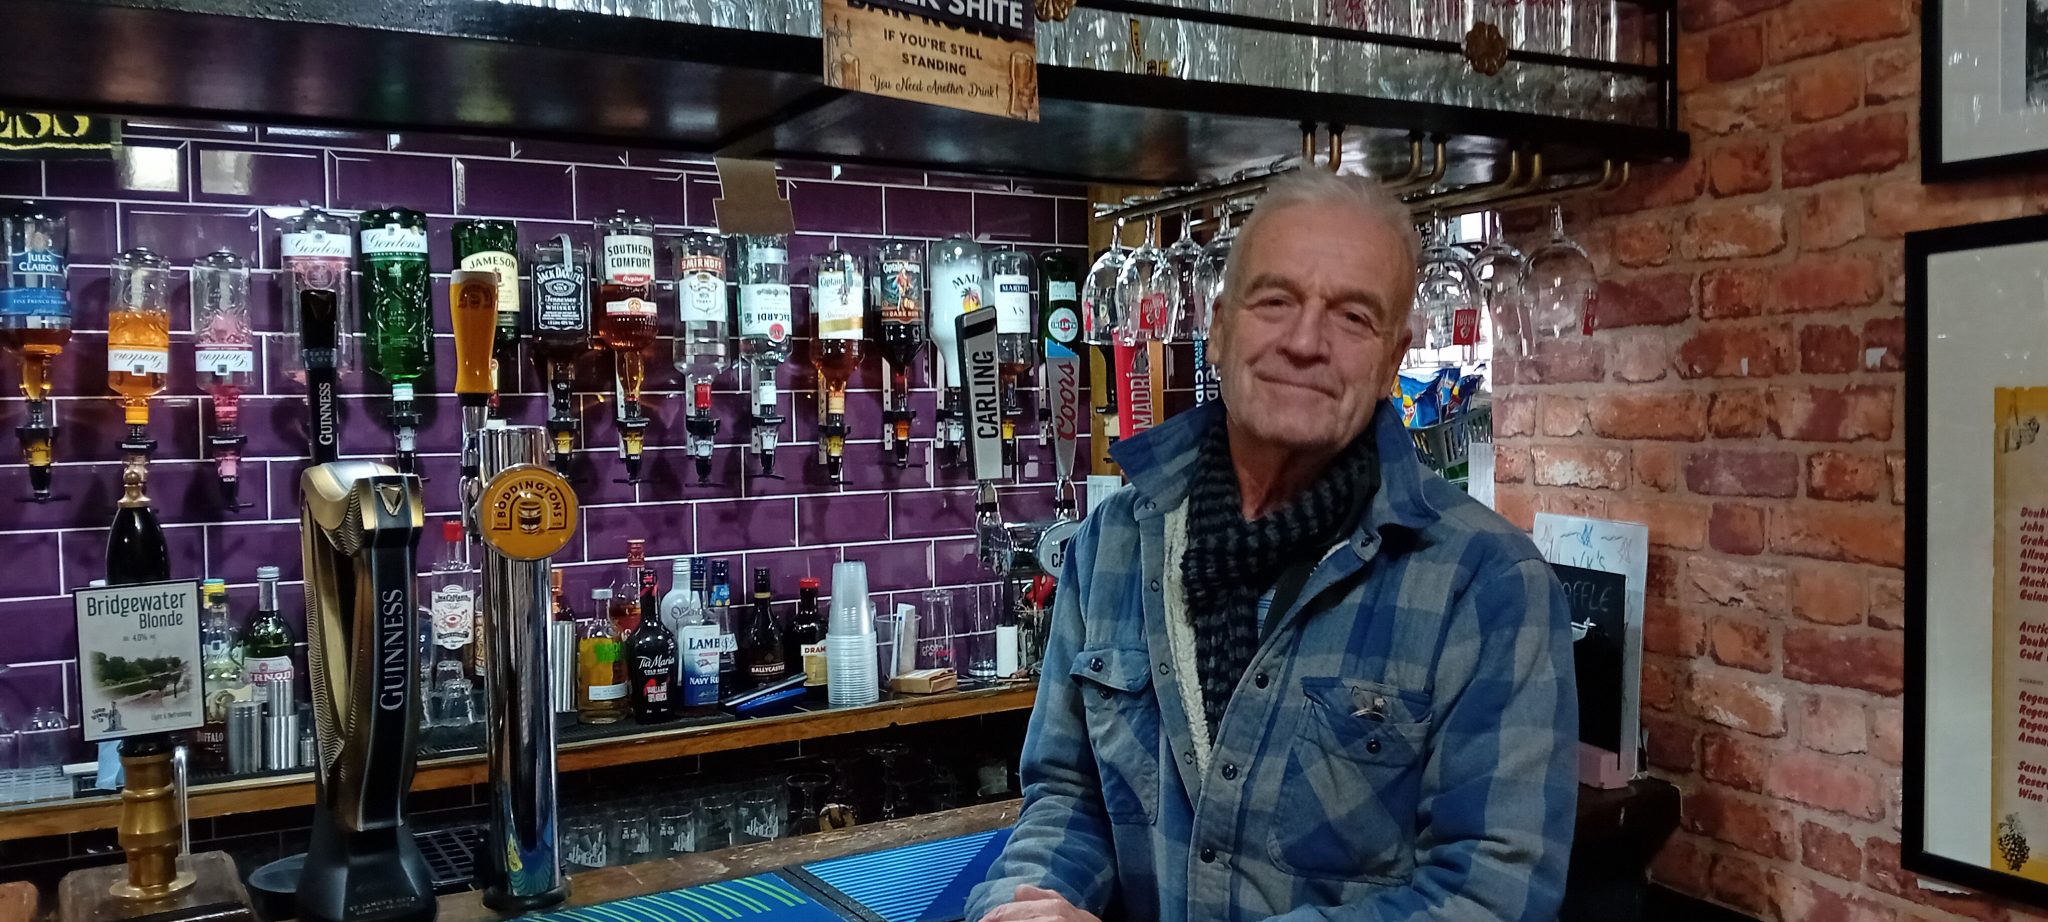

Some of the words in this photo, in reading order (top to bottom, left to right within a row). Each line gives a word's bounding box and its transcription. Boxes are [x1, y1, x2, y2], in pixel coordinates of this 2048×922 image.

[884, 28, 895, 40] IF
[900, 32, 946, 53] YOU'RE
[950, 43, 983, 60] STILL
[902, 53, 967, 76] STANDING
[869, 73, 891, 93] You
[895, 76, 923, 92] Need
[926, 79, 964, 96] Another
[968, 82, 999, 99] Drink!
[27, 252, 52, 264] JULES
[607, 243, 652, 257] SOUTHERN
[18, 261, 59, 272] CLAIRON
[469, 256, 516, 270] JAMESON
[611, 257, 650, 269] COMFORT
[681, 258, 723, 270] SMIRNOFF
[972, 351, 999, 439] CARLING
[1056, 360, 1076, 441] Coors
[319, 382, 333, 446] GUINNESS
[497, 480, 562, 518] BODDINGTONS
[2020, 521, 2045, 532] John
[87, 591, 187, 618] Bridgewater
[139, 611, 184, 629] Blonde
[380, 589, 404, 711] GUINNESS
[650, 654, 675, 668] Maria
[690, 677, 708, 685] NAVY
[2018, 788, 2043, 802] Wine
